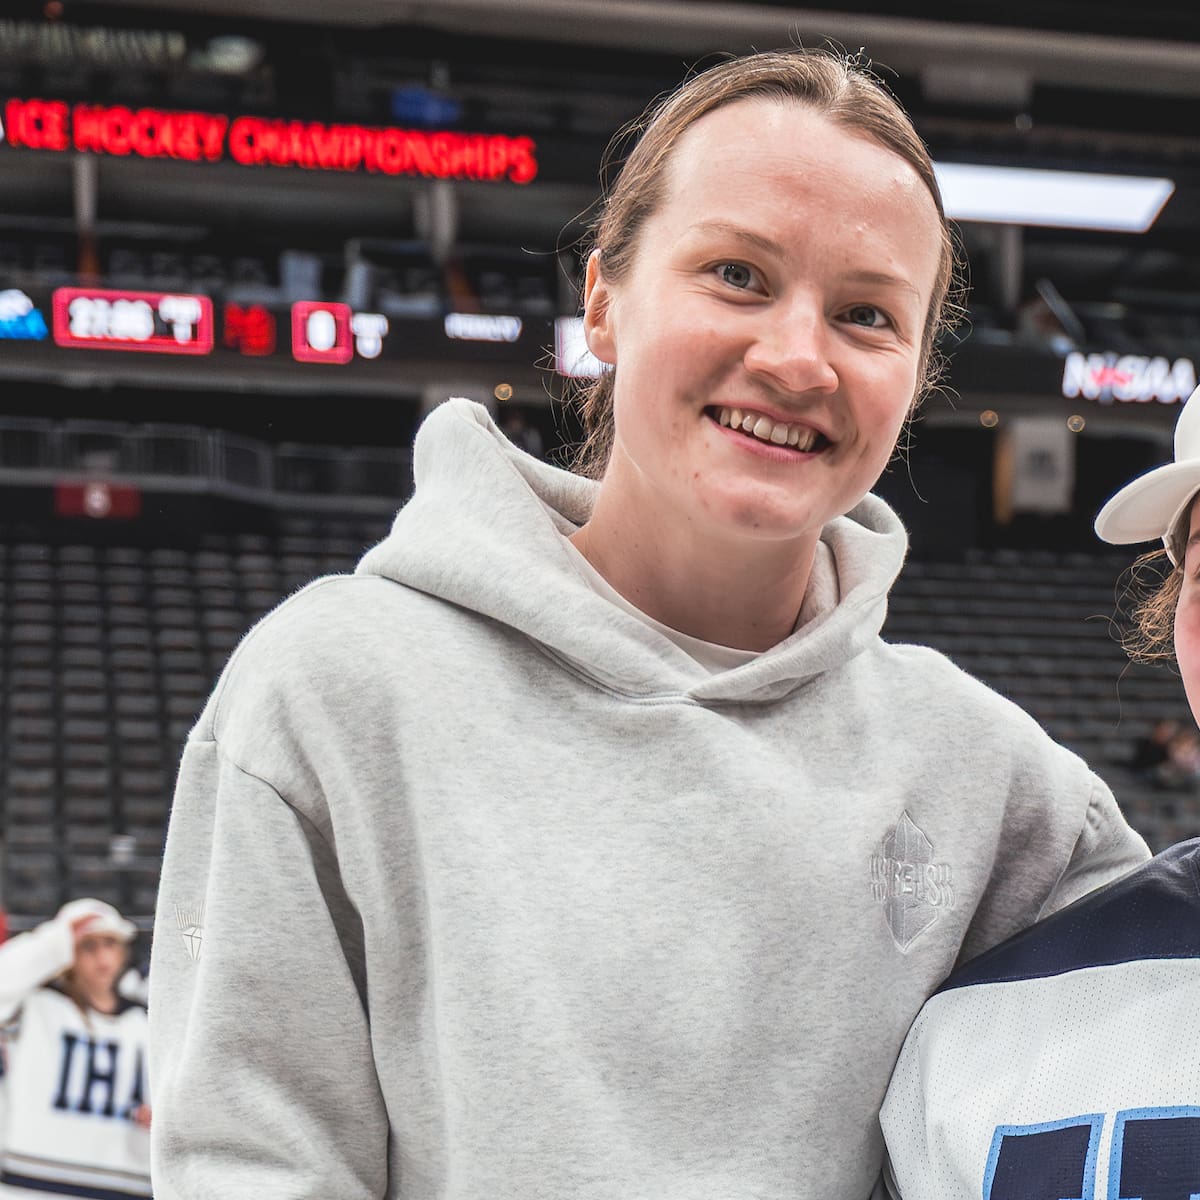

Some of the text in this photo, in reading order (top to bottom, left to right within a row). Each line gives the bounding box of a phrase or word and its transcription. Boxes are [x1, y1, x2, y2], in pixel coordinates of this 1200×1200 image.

[5, 98, 538, 184] ICE HOCKEY CHAMPIONSHIPS
